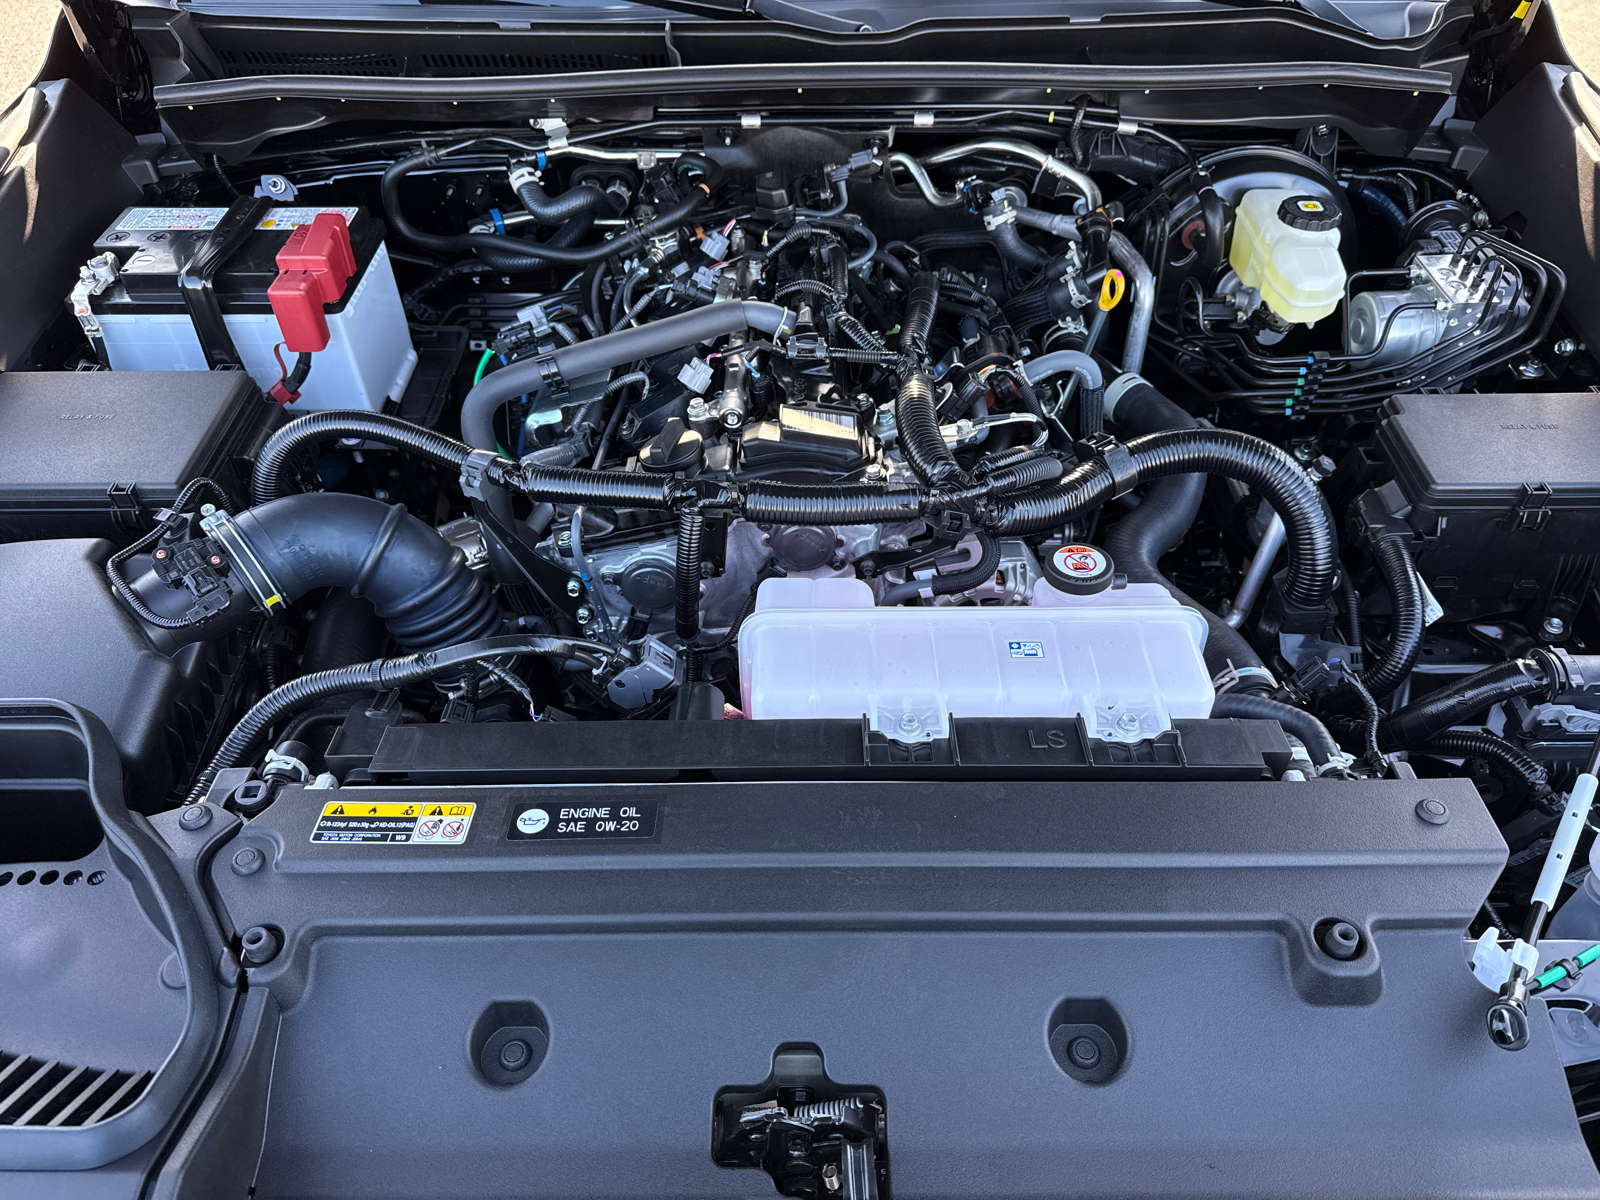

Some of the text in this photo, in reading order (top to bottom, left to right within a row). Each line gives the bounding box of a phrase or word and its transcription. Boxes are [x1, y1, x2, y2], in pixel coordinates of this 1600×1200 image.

[1028, 729, 1067, 749] LS
[560, 807, 641, 819] ENGINE OIL
[557, 820, 640, 833] SAE 0W-20
